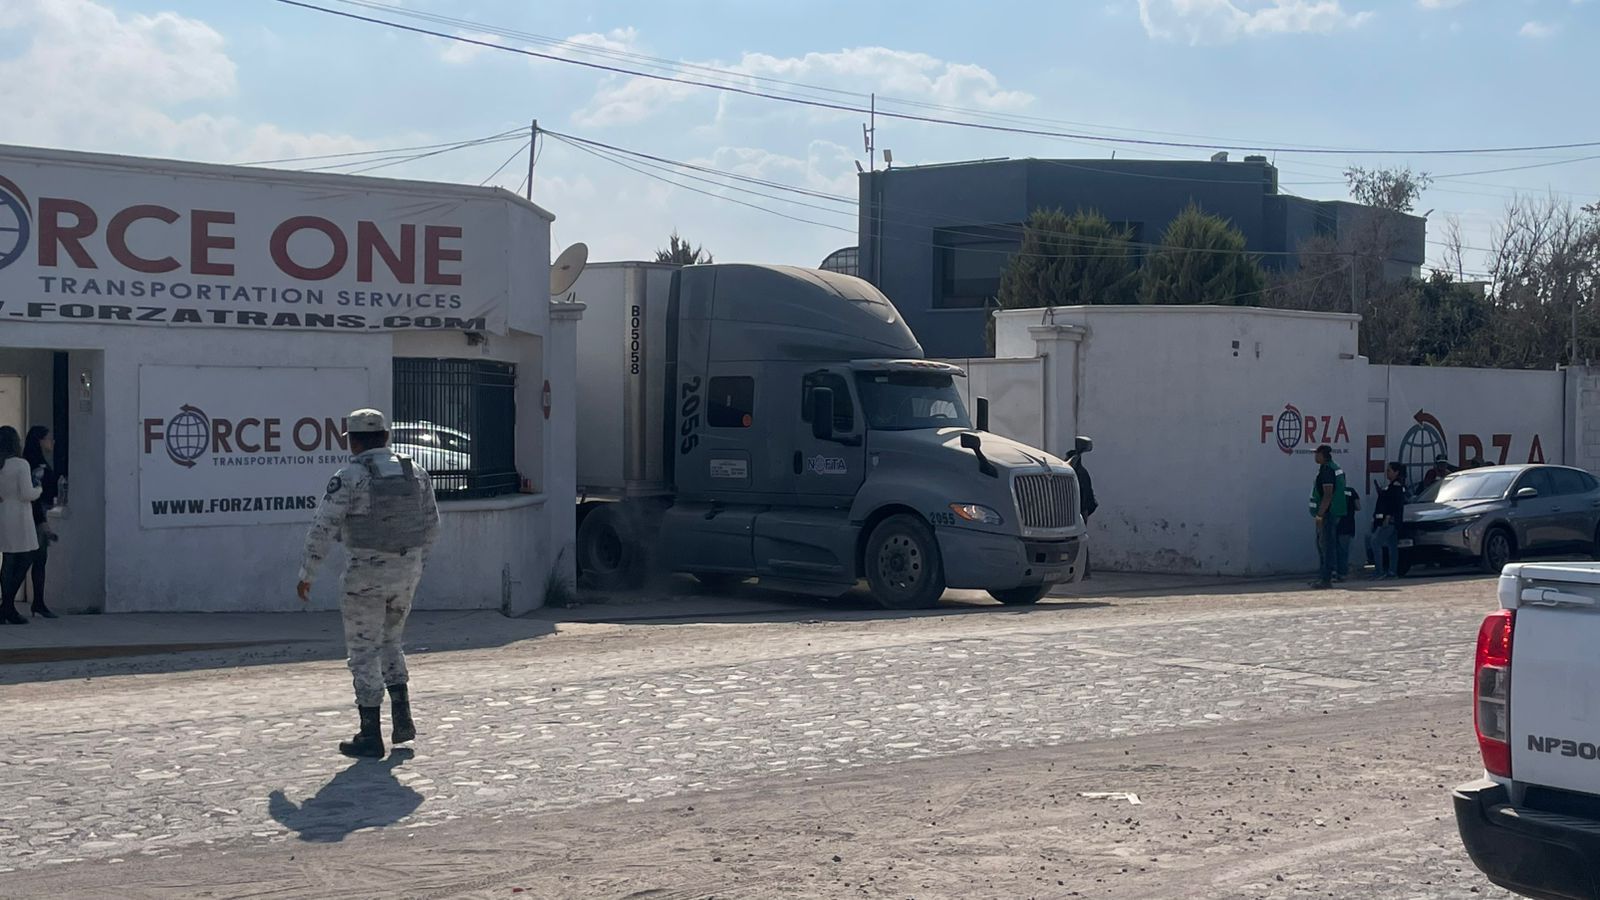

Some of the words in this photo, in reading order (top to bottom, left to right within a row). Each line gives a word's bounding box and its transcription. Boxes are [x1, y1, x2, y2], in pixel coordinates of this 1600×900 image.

[0, 188, 235, 276] RCE
[270, 216, 462, 286] ONE
[38, 276, 323, 304] TRANSPORTATION
[337, 290, 462, 309] SERVICES
[0, 302, 486, 330] .FORZATRANS.COM
[631, 305, 640, 375] B05058
[681, 376, 701, 455] 2055
[1261, 411, 1350, 446] FORZA
[144, 412, 281, 460] FORCE
[293, 417, 348, 452] ON
[213, 456, 314, 467] TRANSPORTATION
[318, 455, 353, 465] SERVIC
[152, 496, 316, 515] WWW.FORZATRANS
[930, 512, 955, 525] 2055
[1528, 735, 1600, 760] NP30
